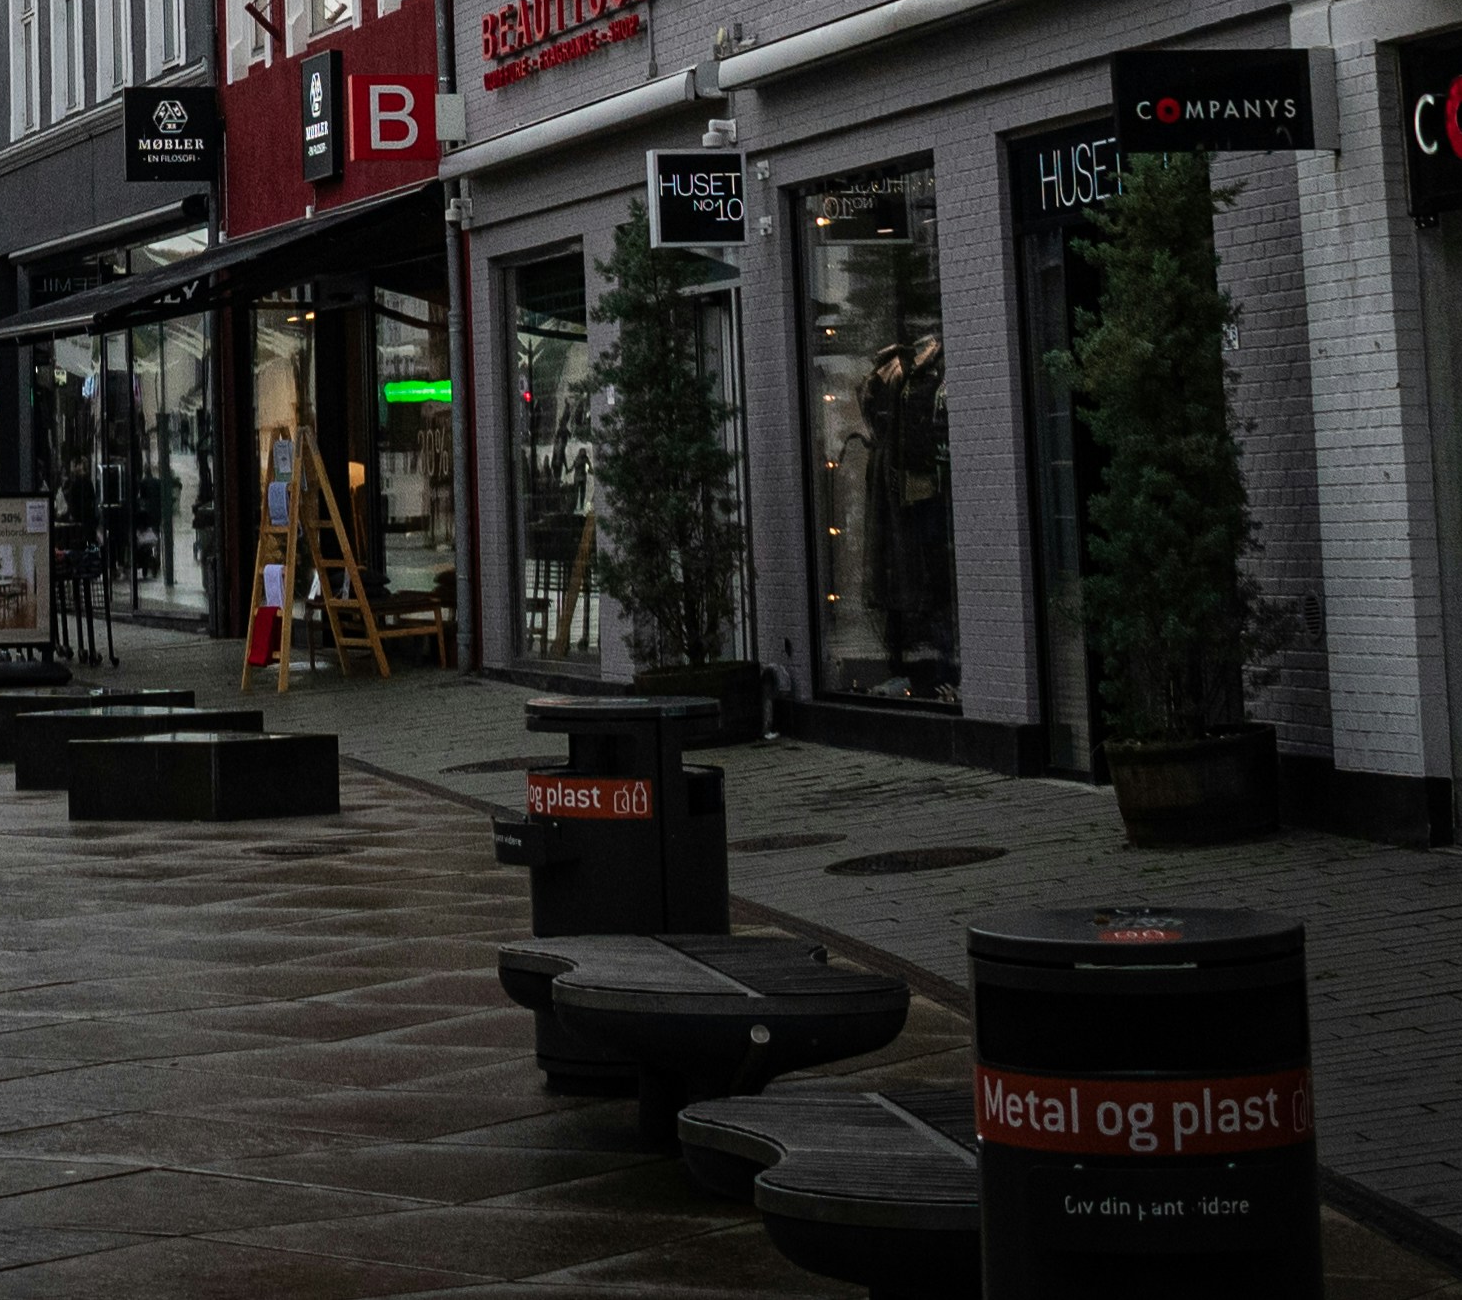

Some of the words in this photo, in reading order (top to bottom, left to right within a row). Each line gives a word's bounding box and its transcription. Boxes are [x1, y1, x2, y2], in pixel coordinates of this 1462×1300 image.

[368, 83, 419, 151] B
[1135, 96, 1297, 126] COMPANYS
[137, 138, 205, 151] MØBLER
[160, 153, 196, 164] FILOSOFI
[659, 172, 742, 197] HUSET
[715, 197, 745, 222] 10
[528, 784, 544, 814] og
[546, 779, 602, 815] plast
[982, 1074, 1080, 1135] Metal
[1095, 1099, 1161, 1153] og
[1173, 1086, 1281, 1153] plast
[1099, 1195, 1132, 1216] din
